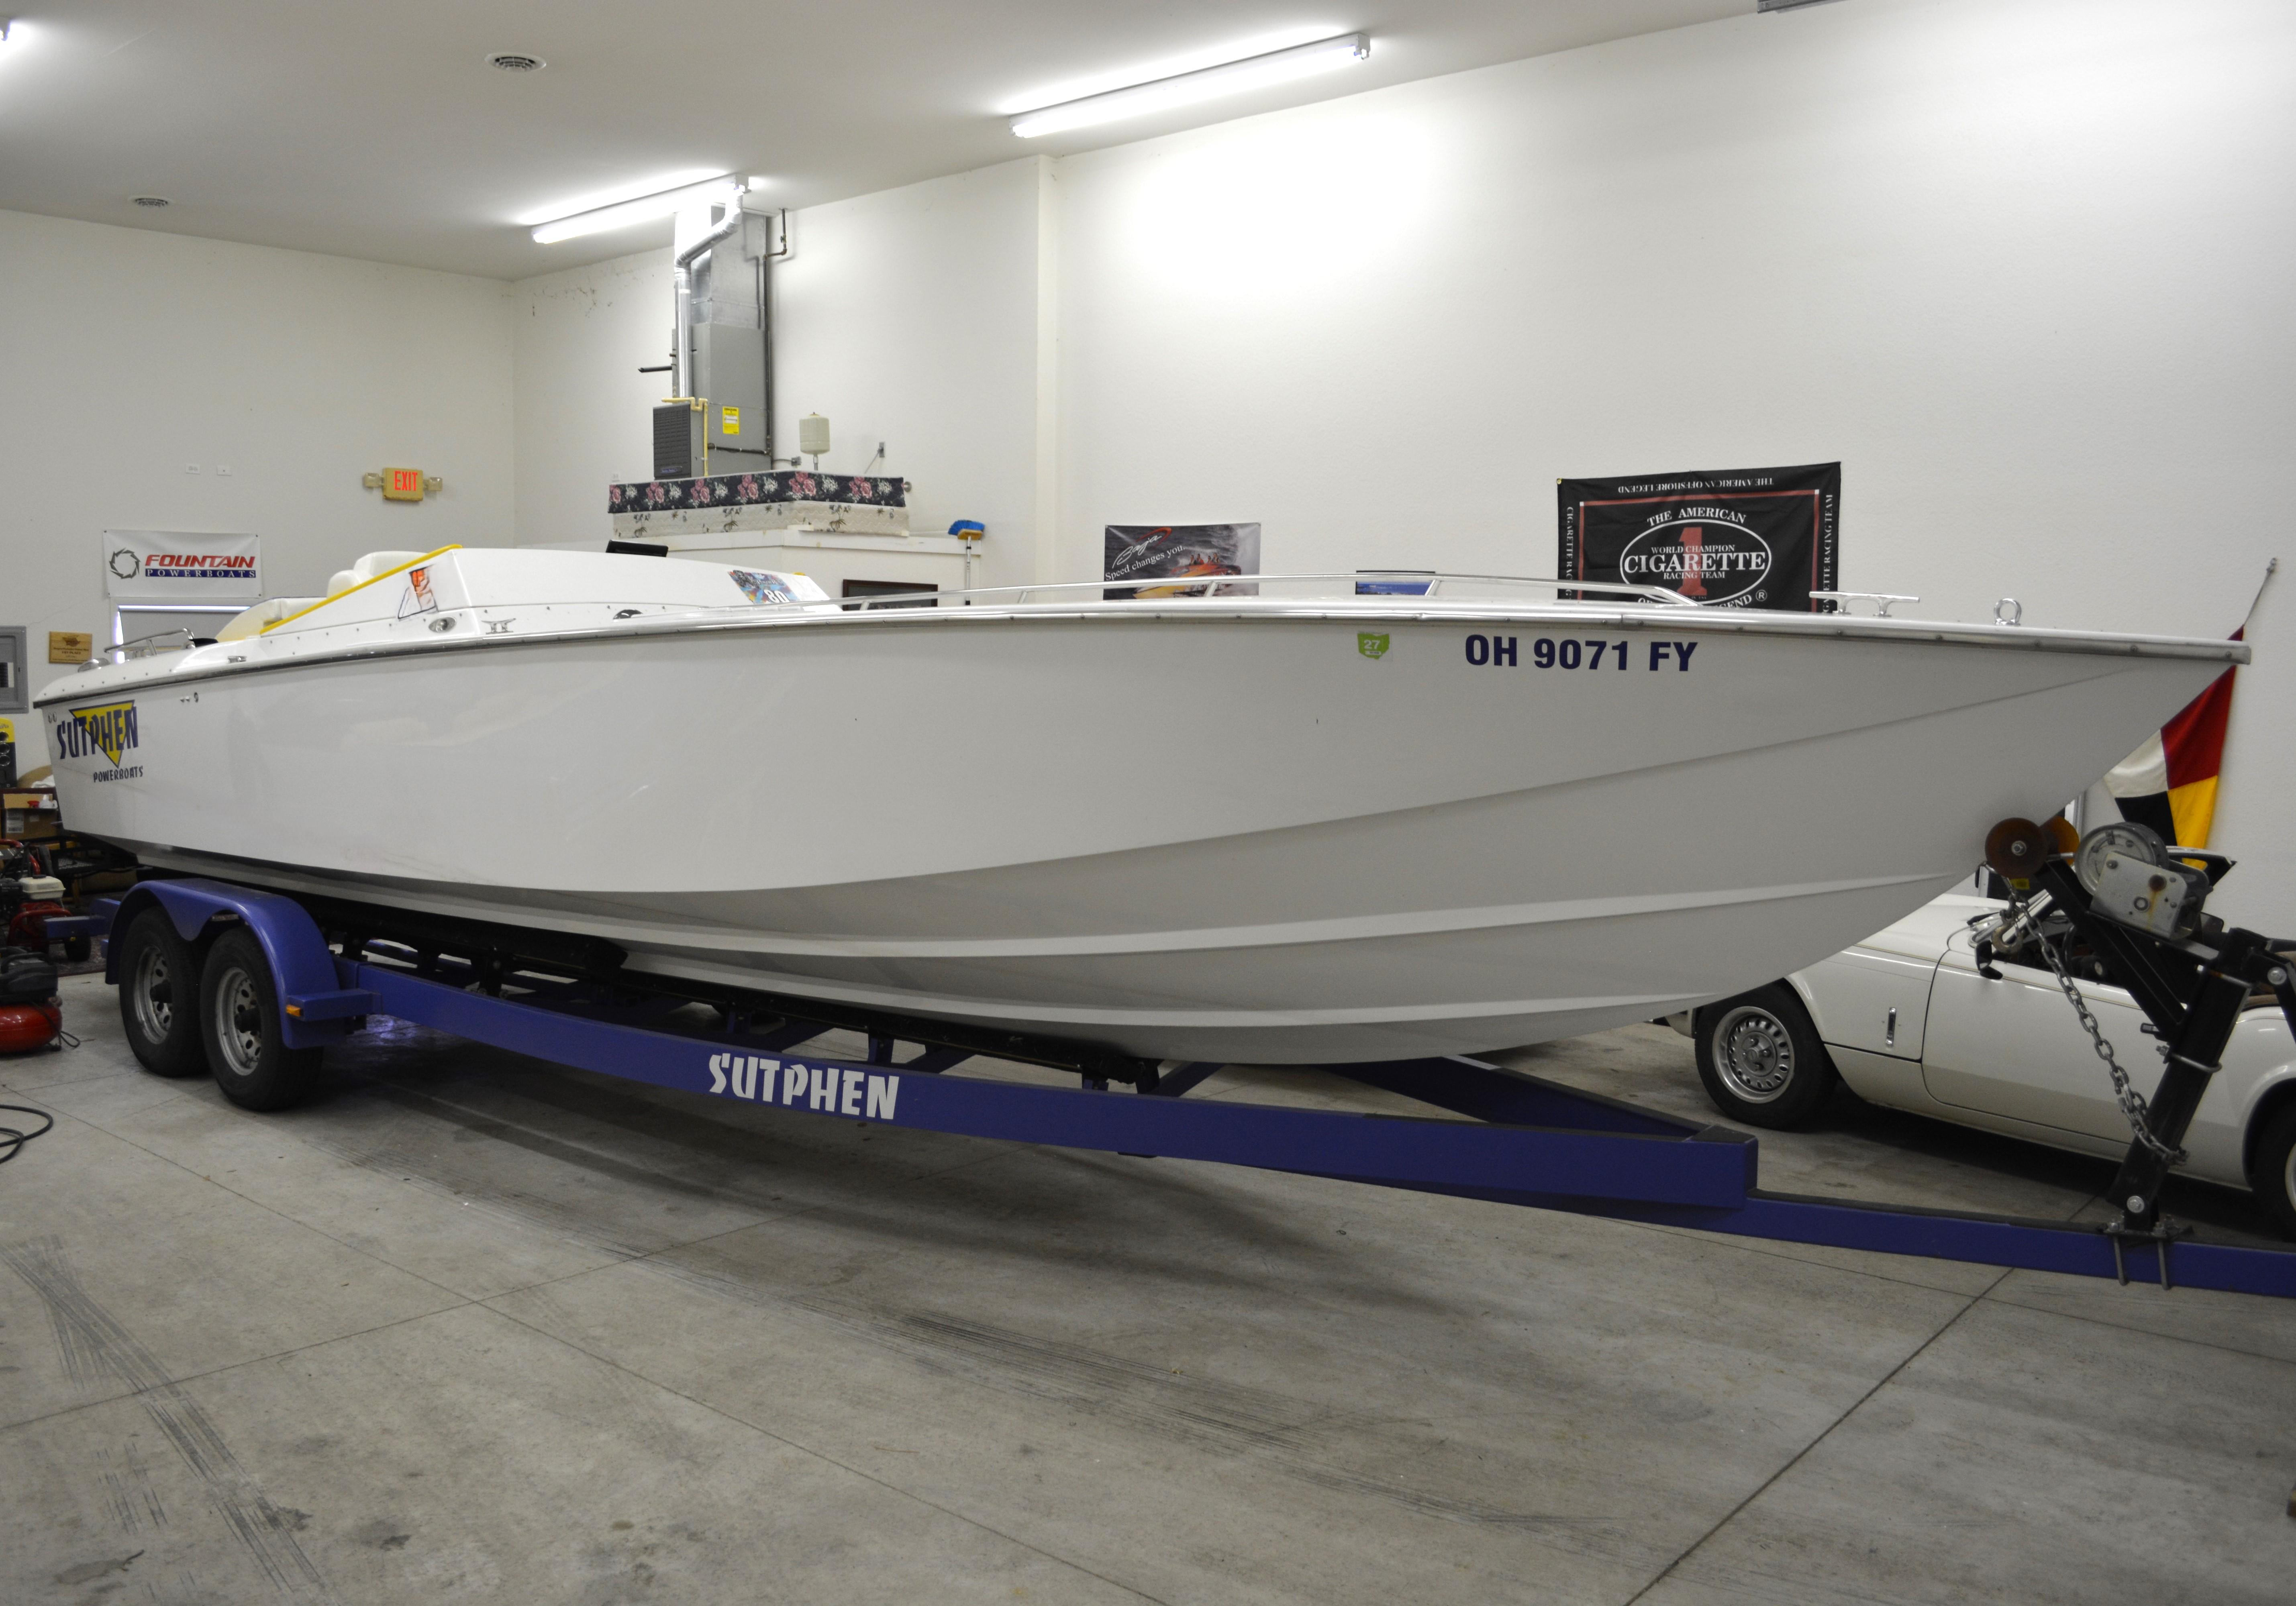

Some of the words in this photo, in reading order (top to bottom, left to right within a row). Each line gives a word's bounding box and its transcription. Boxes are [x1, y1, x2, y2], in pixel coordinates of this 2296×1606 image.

[394, 471, 418, 491] EXIT
[1618, 484, 1653, 493] LEGEND
[1656, 481, 1703, 491] OFFSHORE
[1705, 479, 1751, 488] AMERICAN
[1755, 478, 1774, 486] THE
[1647, 511, 1672, 526] THE
[1678, 507, 1746, 524] AMERICAN
[1112, 535, 1162, 569] Baja
[1651, 546, 1684, 554] WORLD
[1685, 544, 1735, 553] CHAMPION
[145, 554, 255, 568] FOUNTAIN
[1105, 565, 1130, 581] Speed
[1132, 552, 1165, 571] changes
[1166, 546, 1185, 559] you.
[1624, 552, 1766, 573] CIGARETTE
[147, 569, 255, 577] POWERBOATS
[763, 589, 790, 603] 80
[1364, 640, 1380, 649] 27
[1465, 634, 1517, 667] OH
[1534, 638, 1628, 671] 9071
[1649, 642, 1698, 671] FY
[57, 706, 138, 759] SUTPHEN
[94, 766, 143, 783] POWERBOATS
[709, 1053, 900, 1119] SUTPHEN
